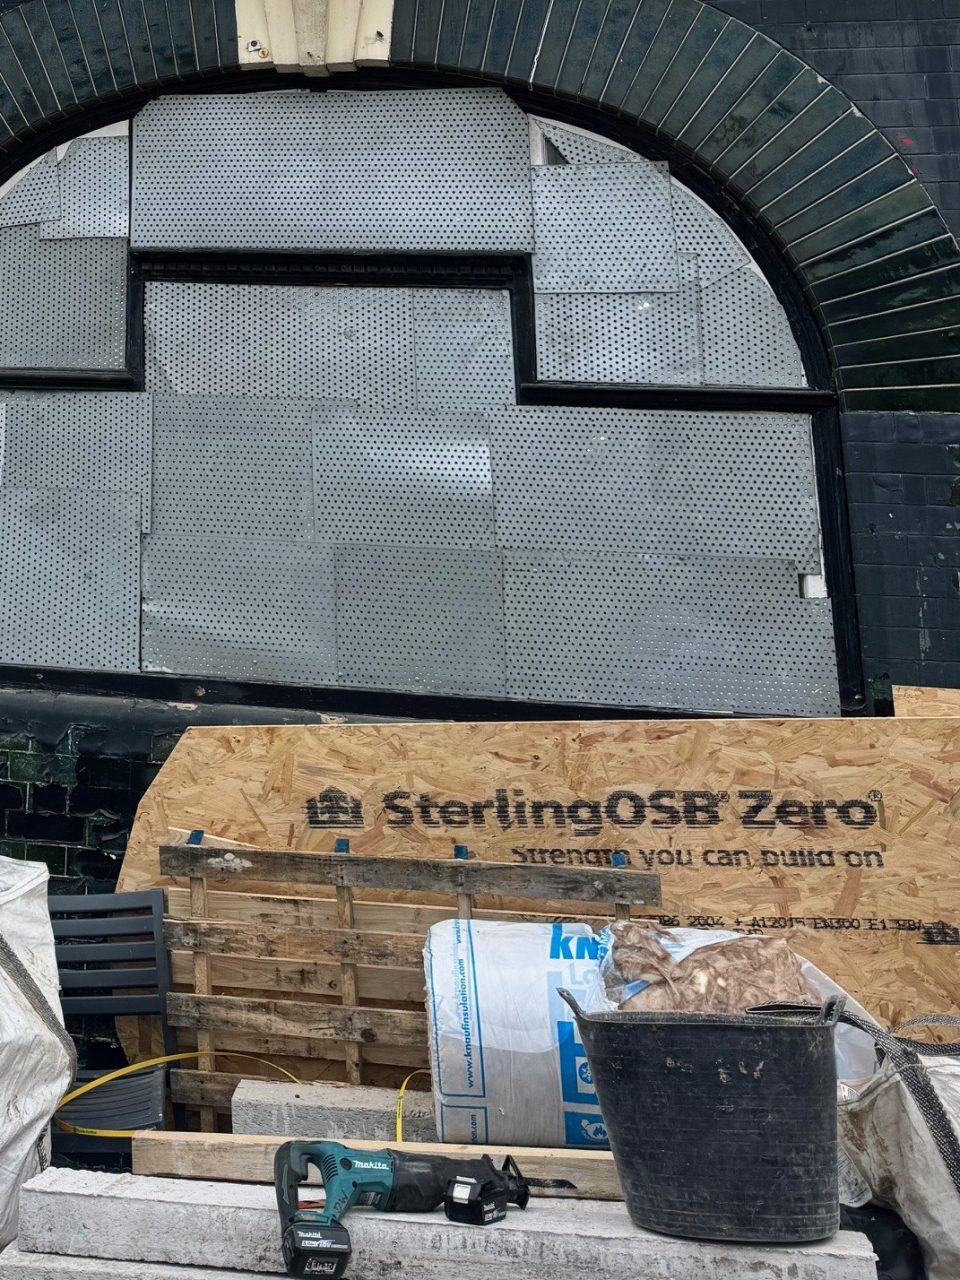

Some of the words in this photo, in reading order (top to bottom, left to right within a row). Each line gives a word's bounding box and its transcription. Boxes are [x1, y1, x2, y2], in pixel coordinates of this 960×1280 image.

[639, 848, 693, 869] you
[701, 849, 751, 867] can
[842, 849, 885, 868] on
[459, 958, 474, 1089] www.knaufinsulation.com
